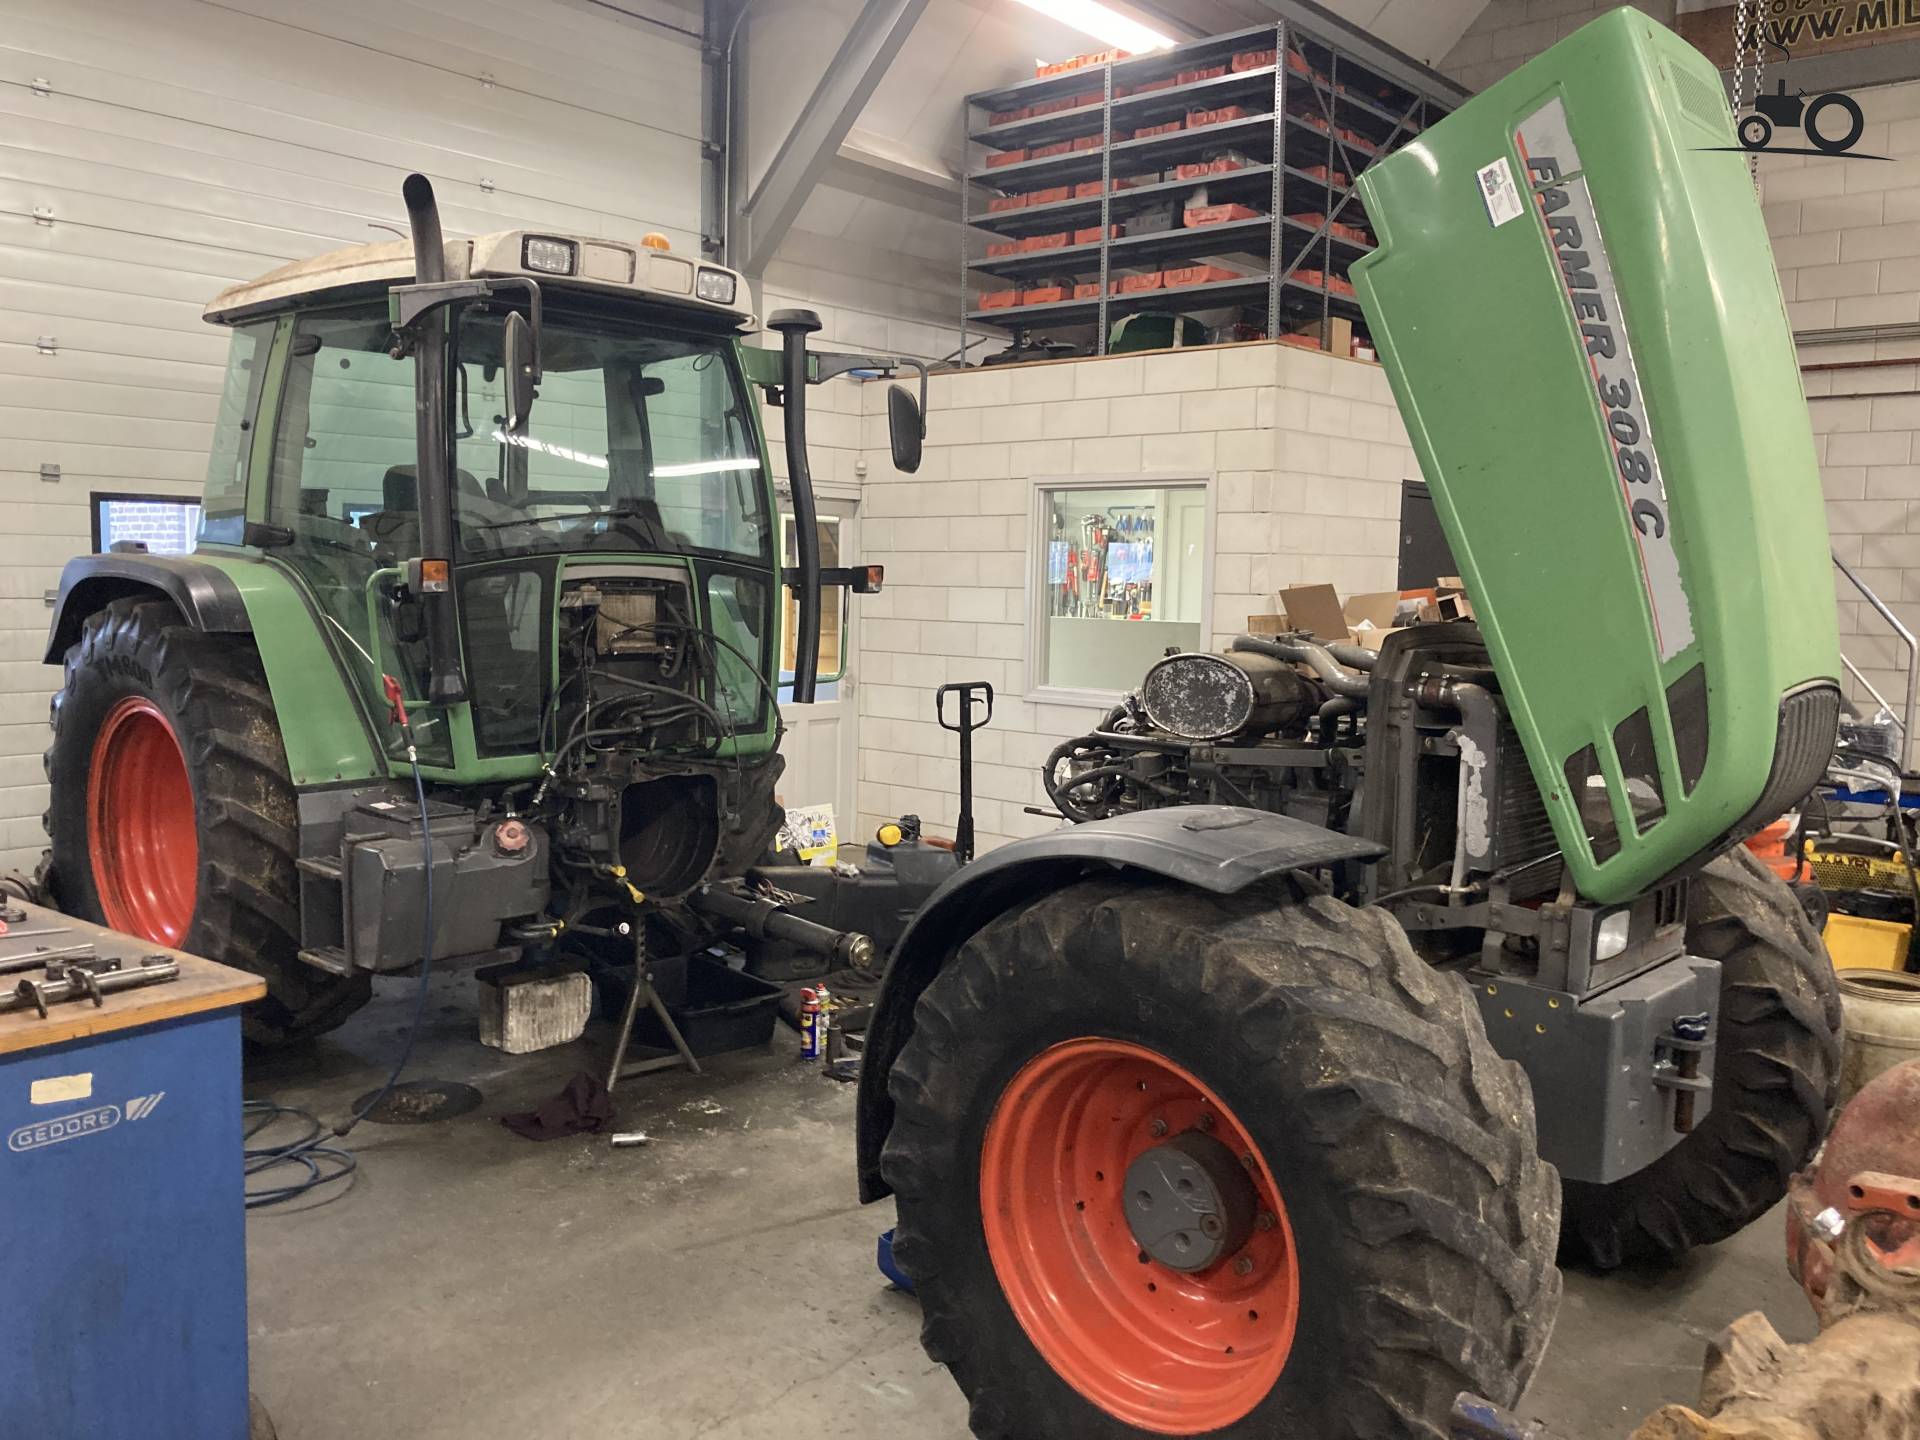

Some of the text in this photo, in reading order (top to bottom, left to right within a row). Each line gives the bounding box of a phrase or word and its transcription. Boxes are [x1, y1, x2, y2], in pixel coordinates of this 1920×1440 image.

[1526, 156, 1665, 539] FARMER 308 C
[17, 1110, 111, 1146] GEDORE
